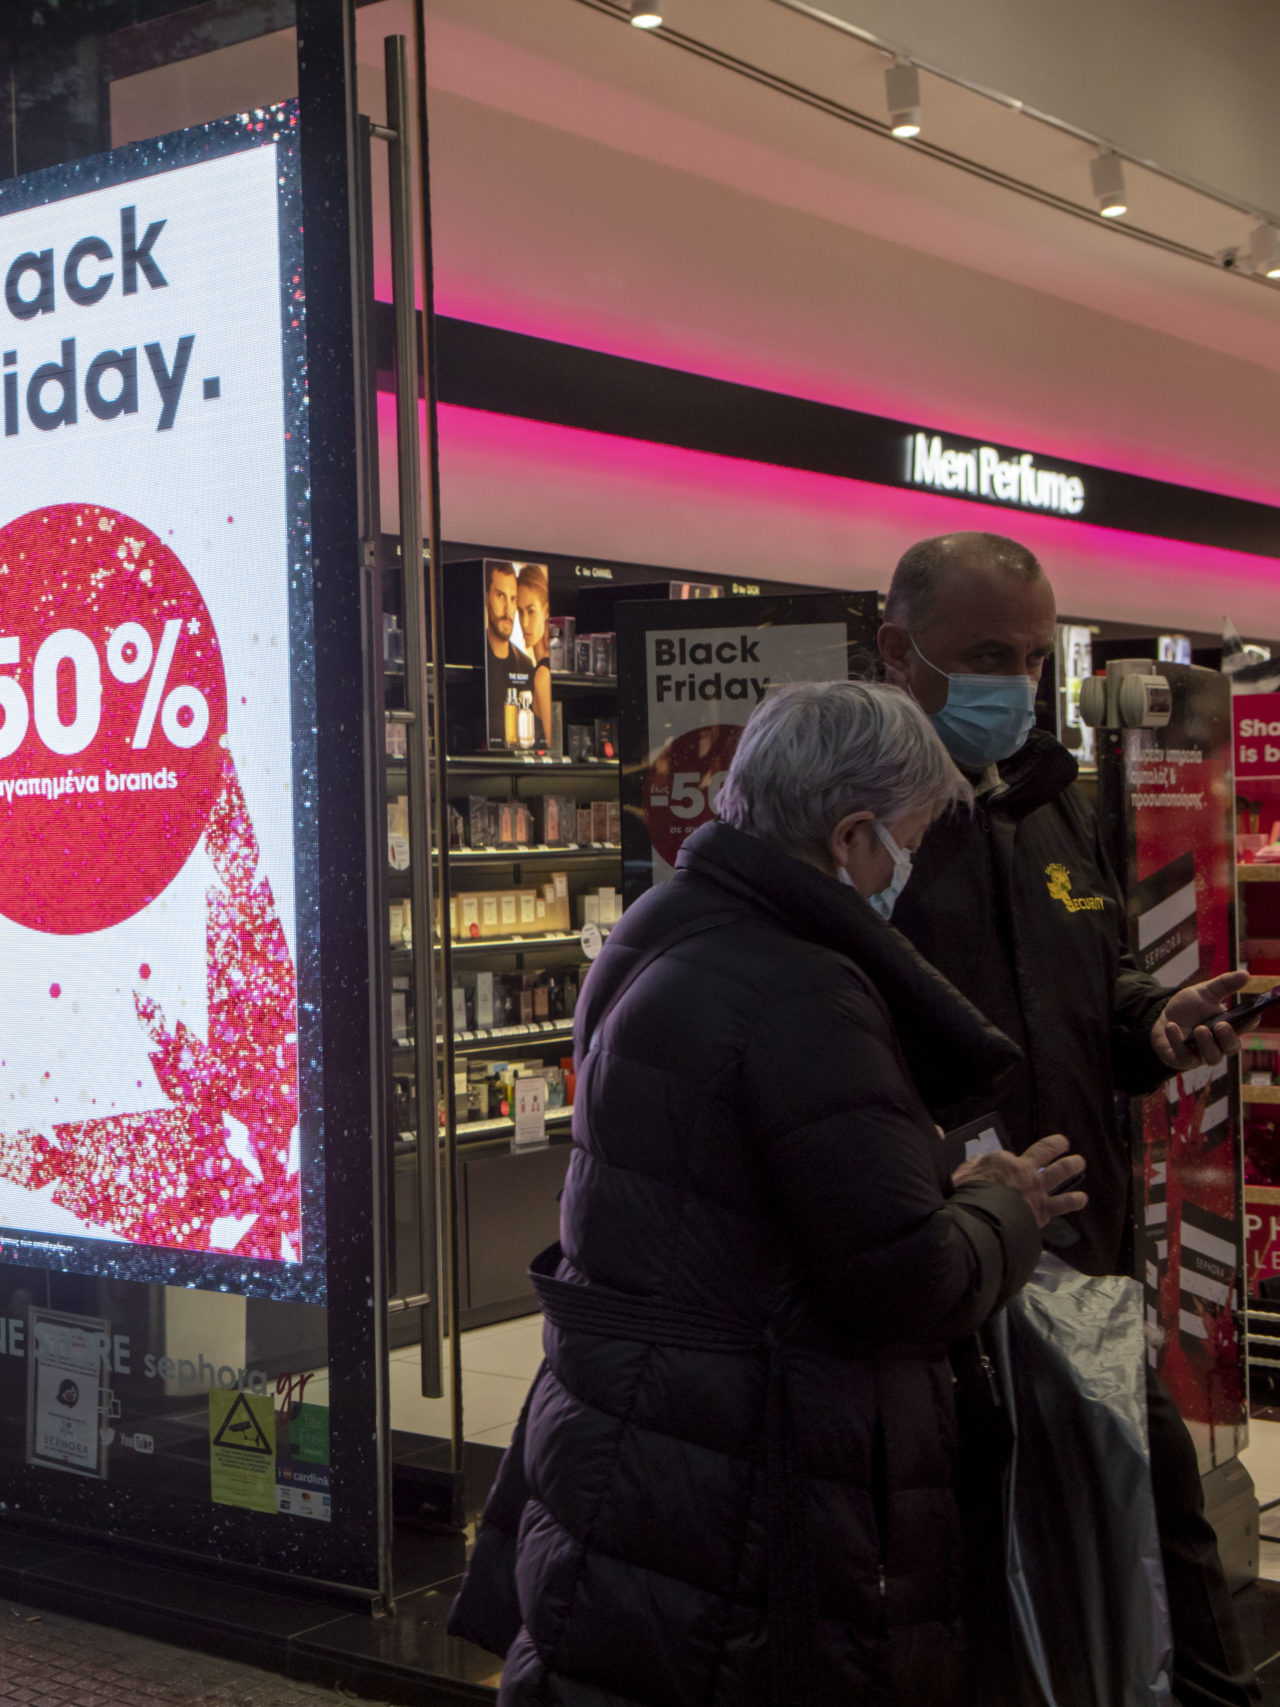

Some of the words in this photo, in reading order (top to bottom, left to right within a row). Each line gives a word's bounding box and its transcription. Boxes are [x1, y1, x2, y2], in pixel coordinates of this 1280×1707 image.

[913, 432, 977, 494] Men
[979, 446, 1085, 514] Perfume
[655, 635, 760, 666] Black
[105, 768, 178, 793] brands
[43, 1434, 89, 1454] SEPHORA
